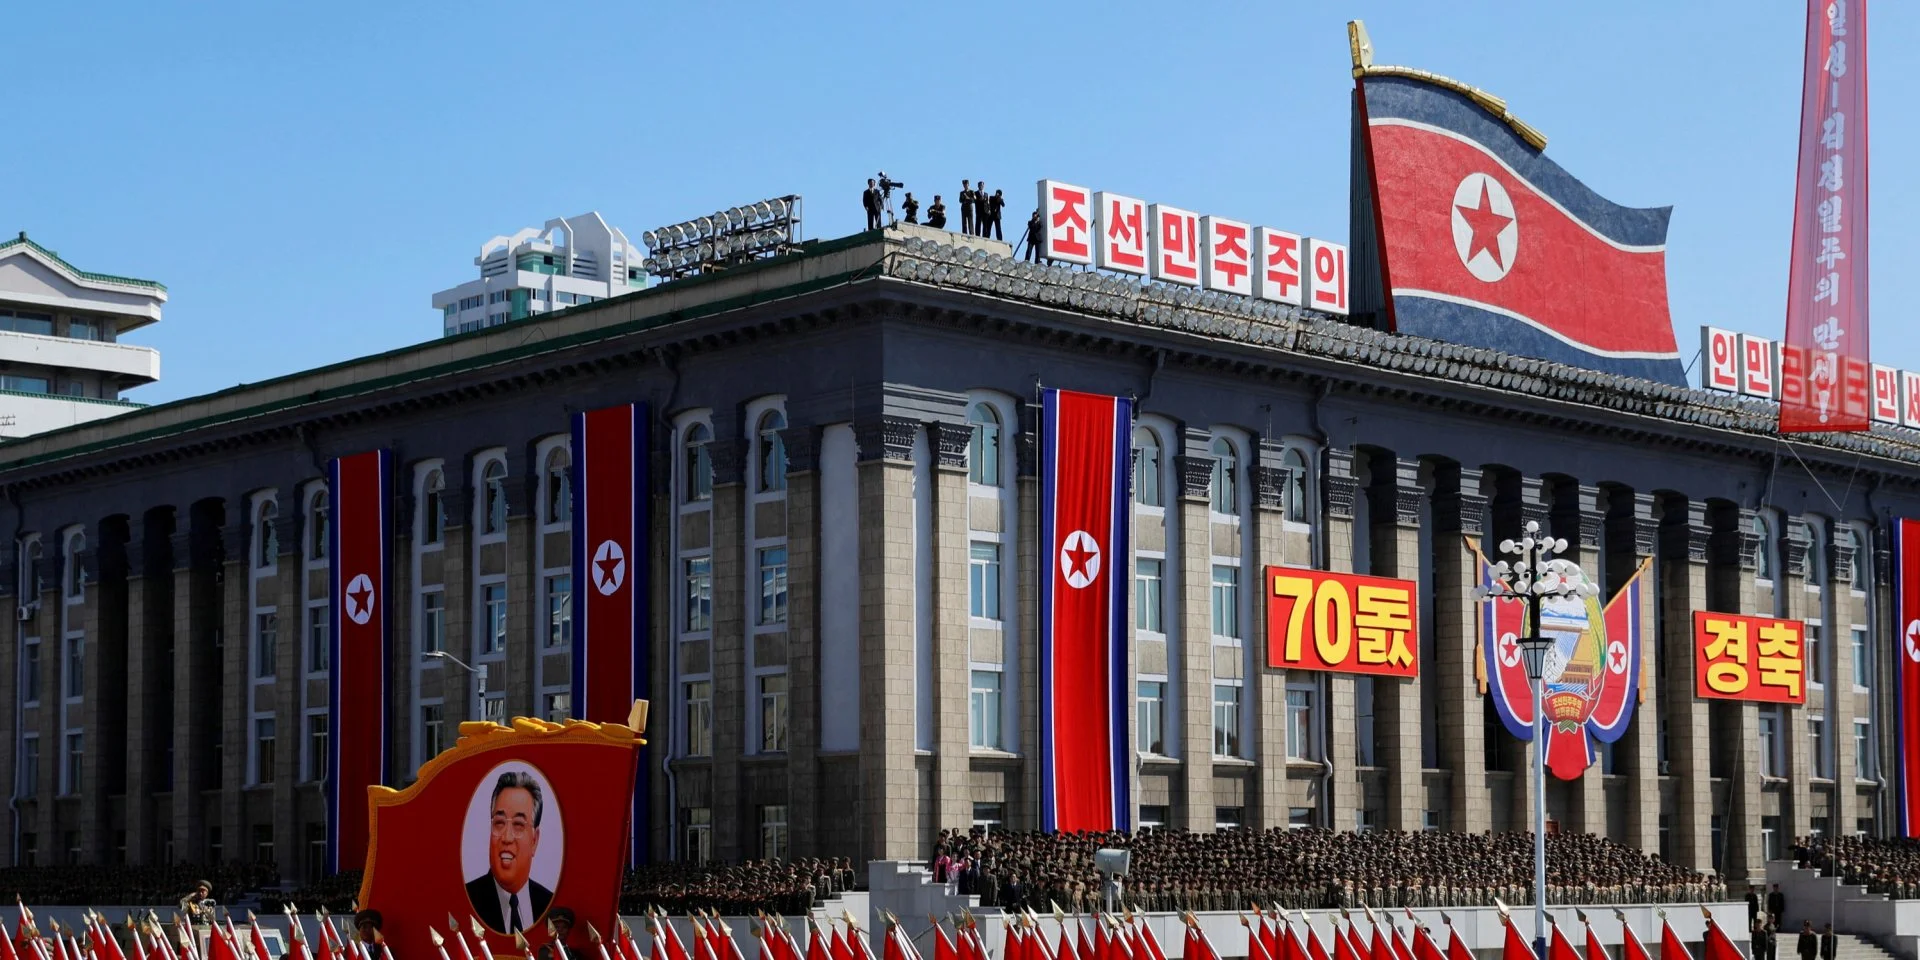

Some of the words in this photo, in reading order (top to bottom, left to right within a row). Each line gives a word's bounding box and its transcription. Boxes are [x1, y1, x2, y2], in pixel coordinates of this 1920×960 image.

[1053, 187, 1345, 309] 조선민주주의
[1808, 317, 1844, 423] 만세!
[1275, 575, 1415, 667] 70돐
[1703, 619, 1802, 697] 경축
